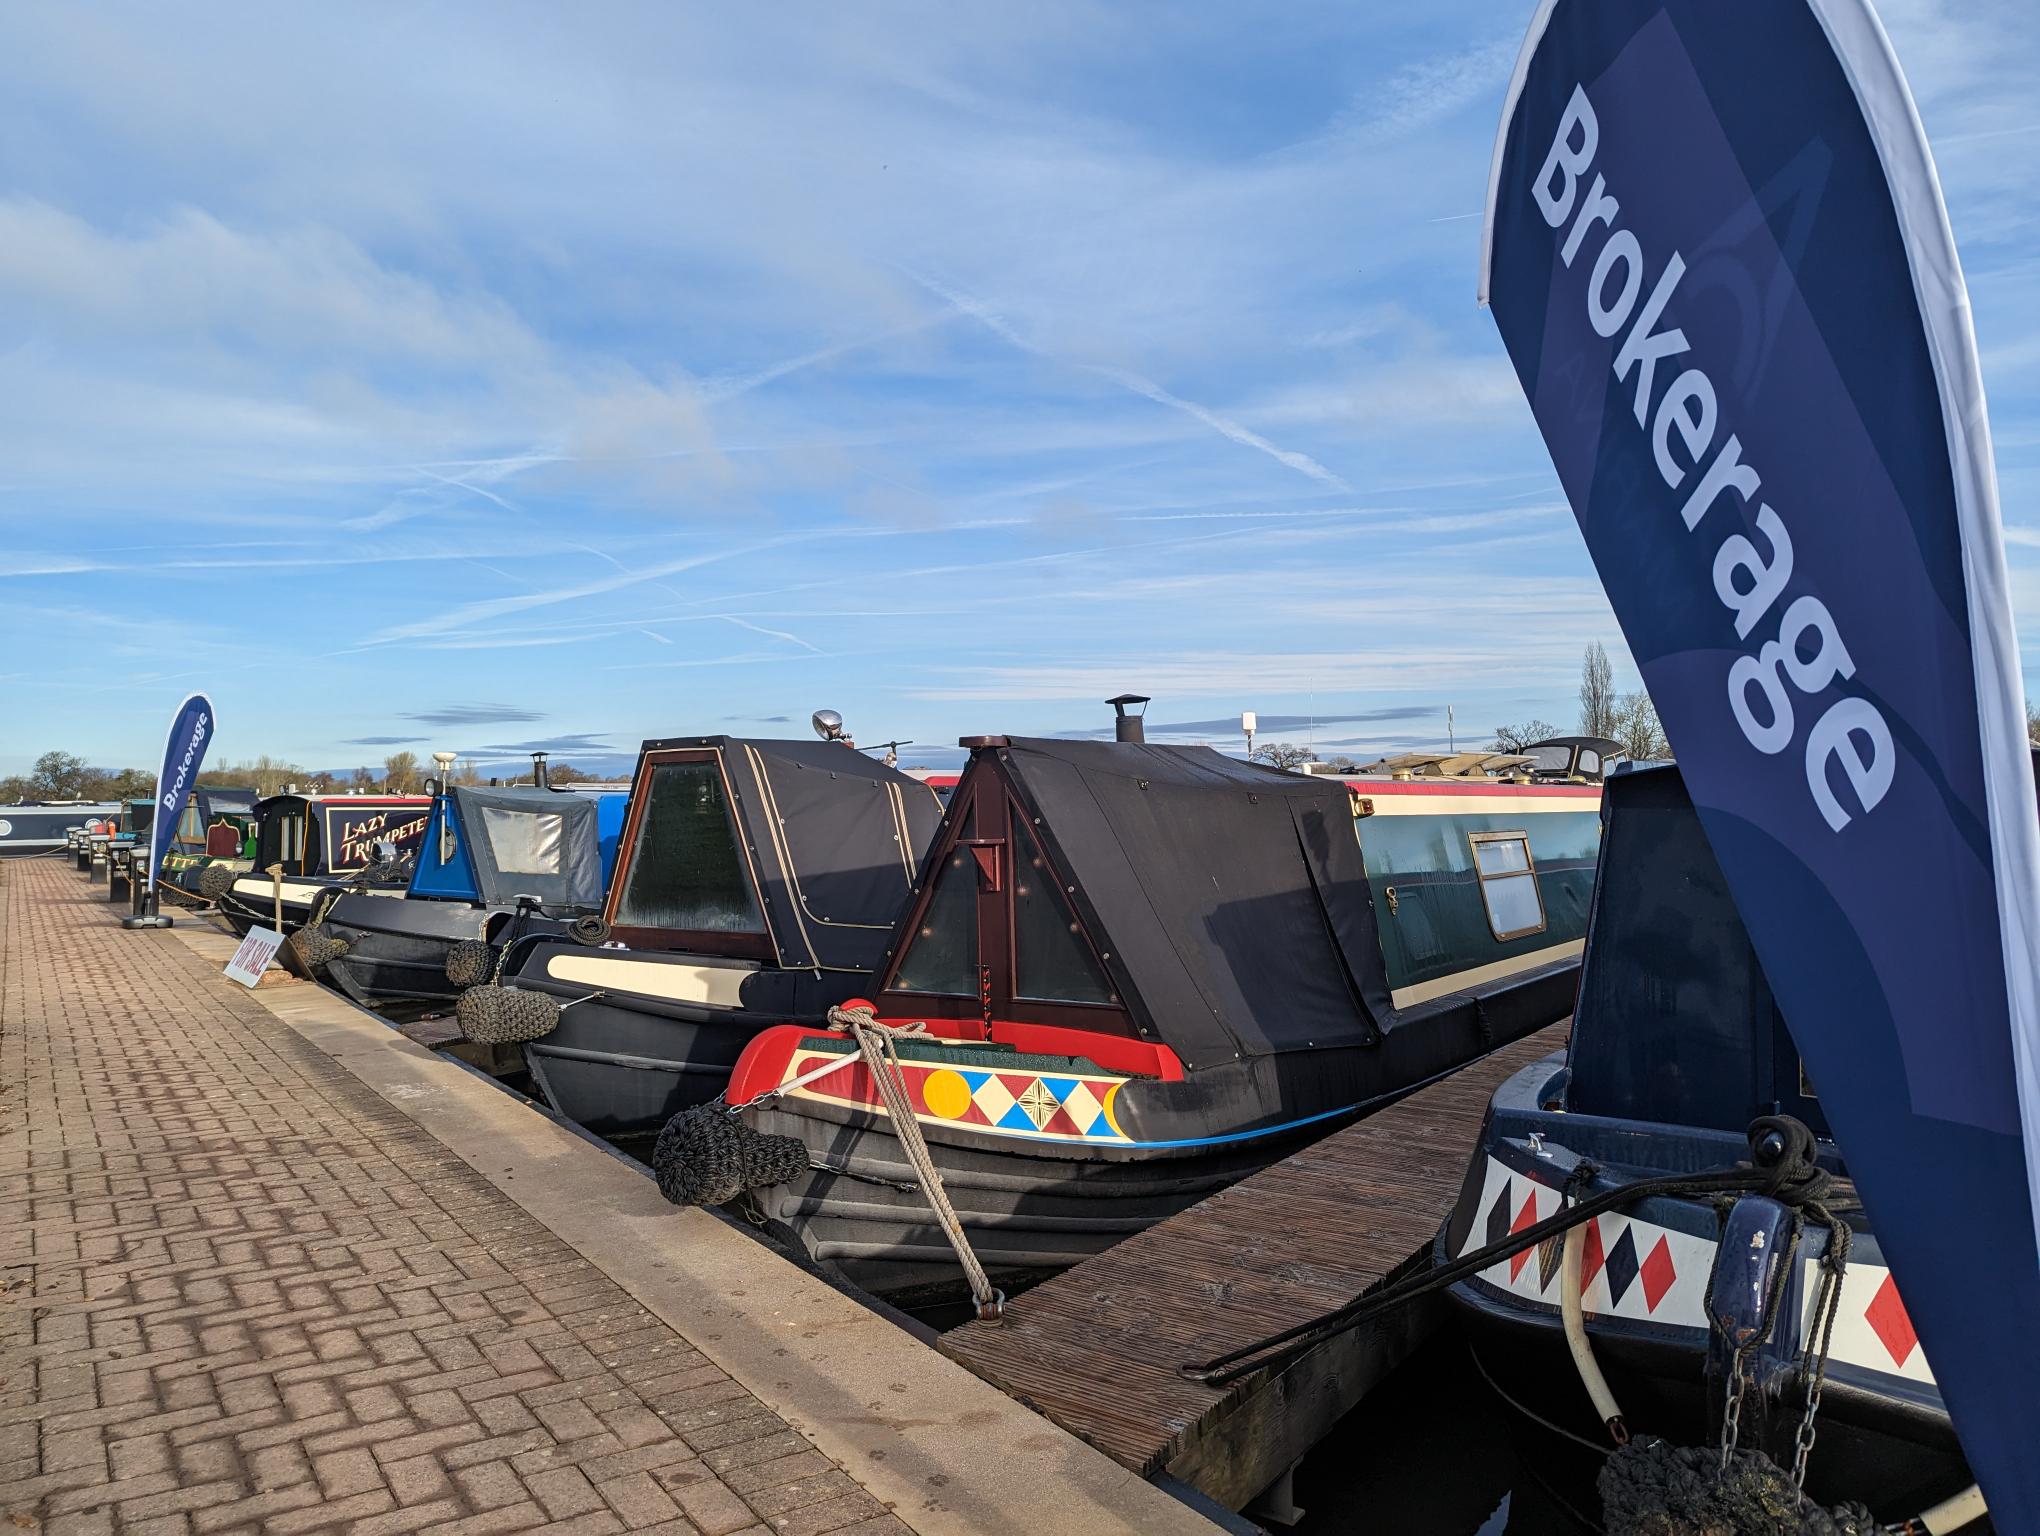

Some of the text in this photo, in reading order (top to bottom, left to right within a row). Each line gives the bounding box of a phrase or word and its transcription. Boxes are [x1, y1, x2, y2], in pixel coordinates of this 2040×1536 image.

[1532, 83, 1896, 833] Brokerage
[163, 712, 208, 812] Brokerage
[340, 816, 428, 864] TRUMPETE
[342, 813, 388, 842] LAZY
[231, 937, 276, 977] FOR SALE
